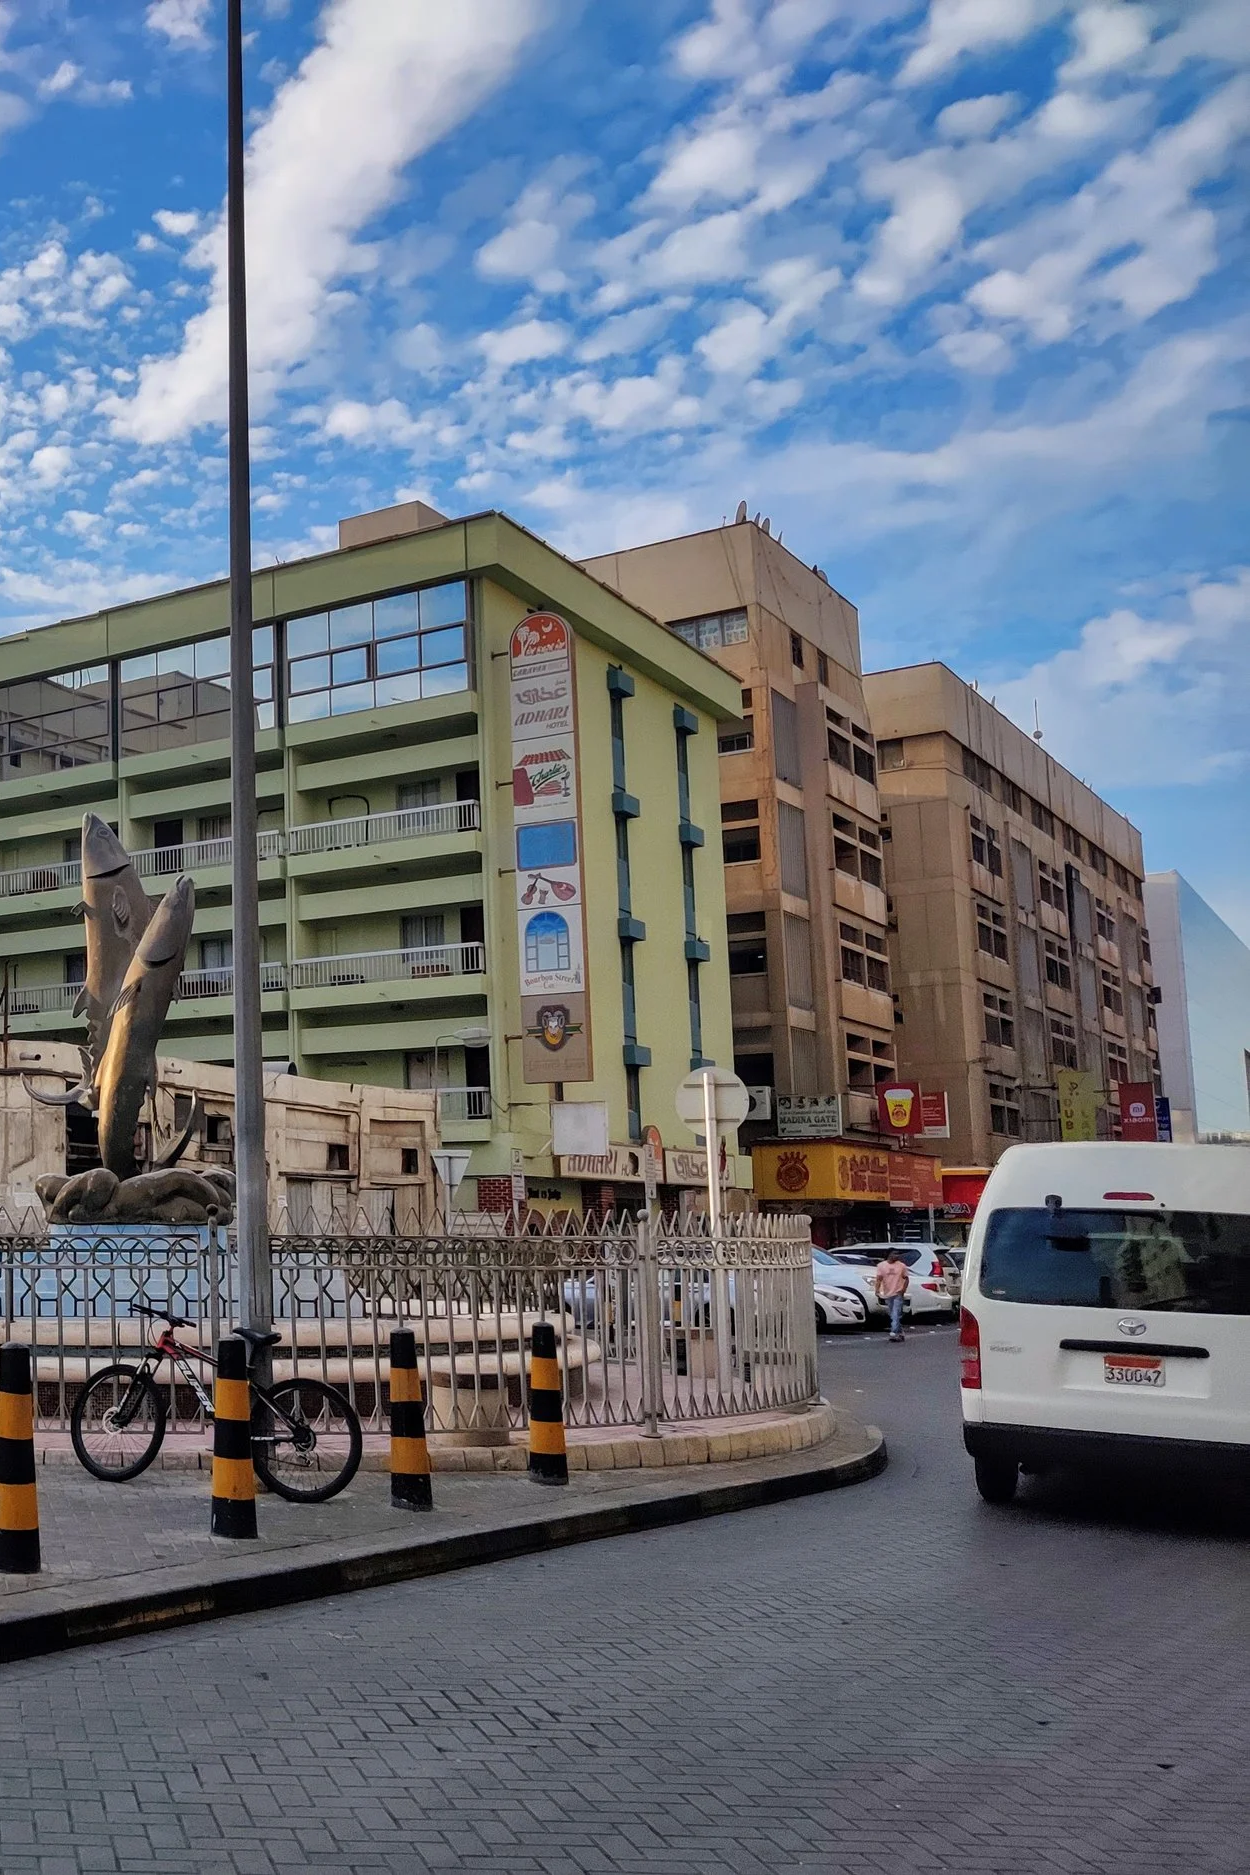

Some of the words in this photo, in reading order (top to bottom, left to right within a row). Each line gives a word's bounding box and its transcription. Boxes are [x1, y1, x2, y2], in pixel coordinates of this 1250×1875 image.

[514, 705, 570, 727] ADHARI
[546, 720, 569, 729] HOTEL
[780, 1115, 812, 1125] MADINA
[814, 1115, 838, 1124] GATE
[1104, 1365, 1162, 1385] 330047
[177, 1359, 216, 1412] SUPER
